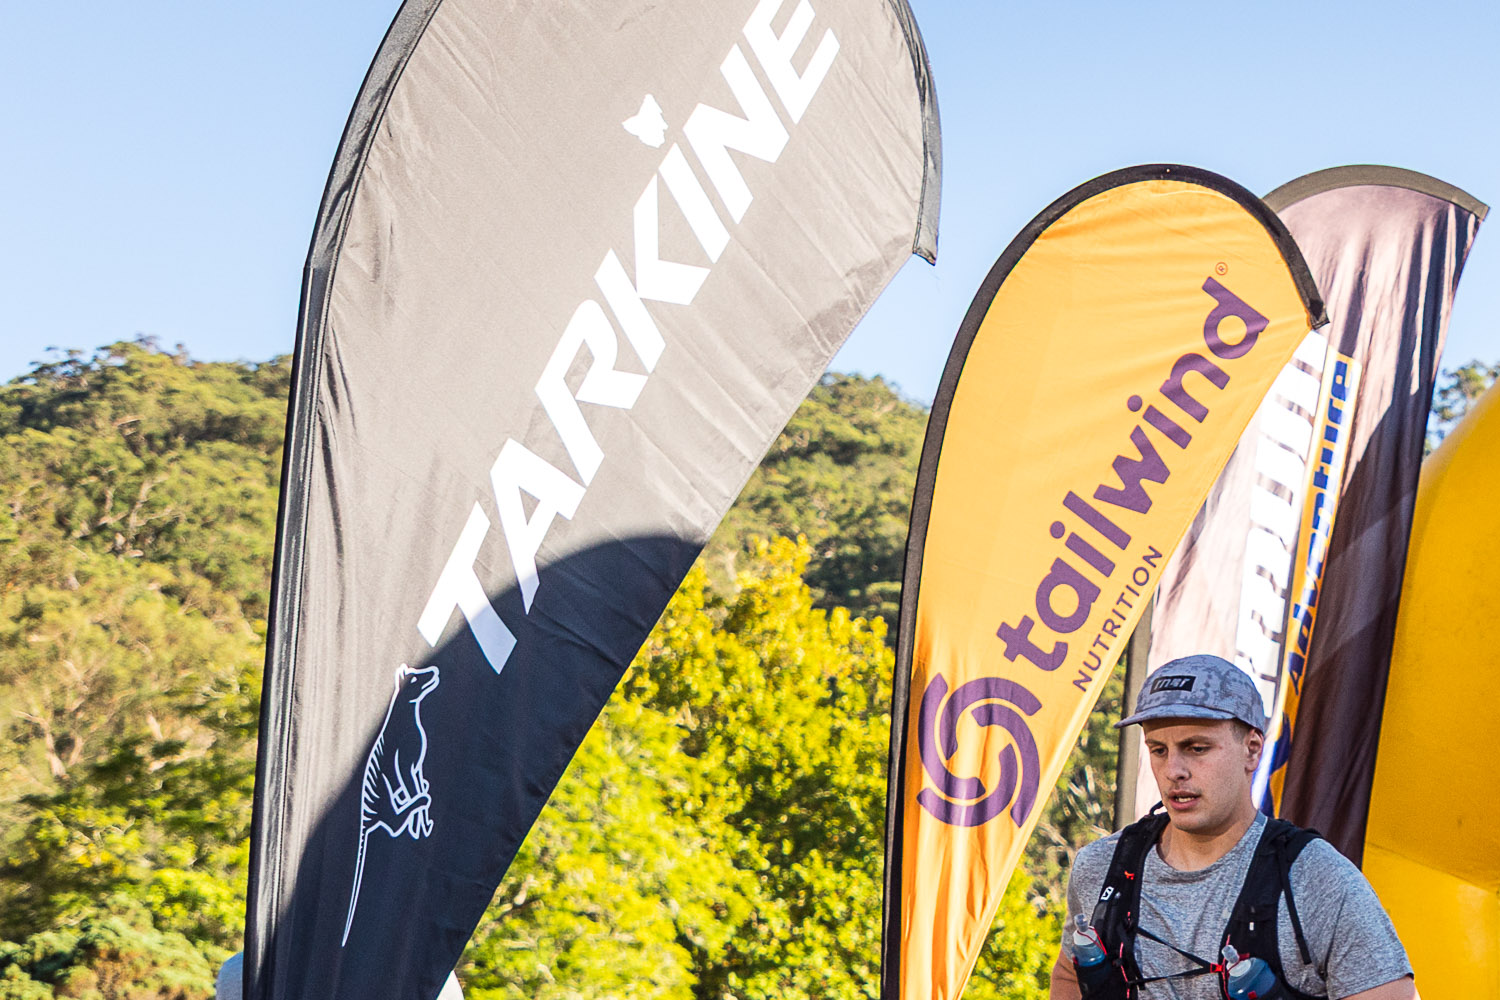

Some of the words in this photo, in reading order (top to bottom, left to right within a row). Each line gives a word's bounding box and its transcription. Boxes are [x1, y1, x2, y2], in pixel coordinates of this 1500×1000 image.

[416, 0, 841, 674] TARKINE
[996, 276, 1269, 672] tailwind
[1073, 544, 1164, 692] NUTRITION
